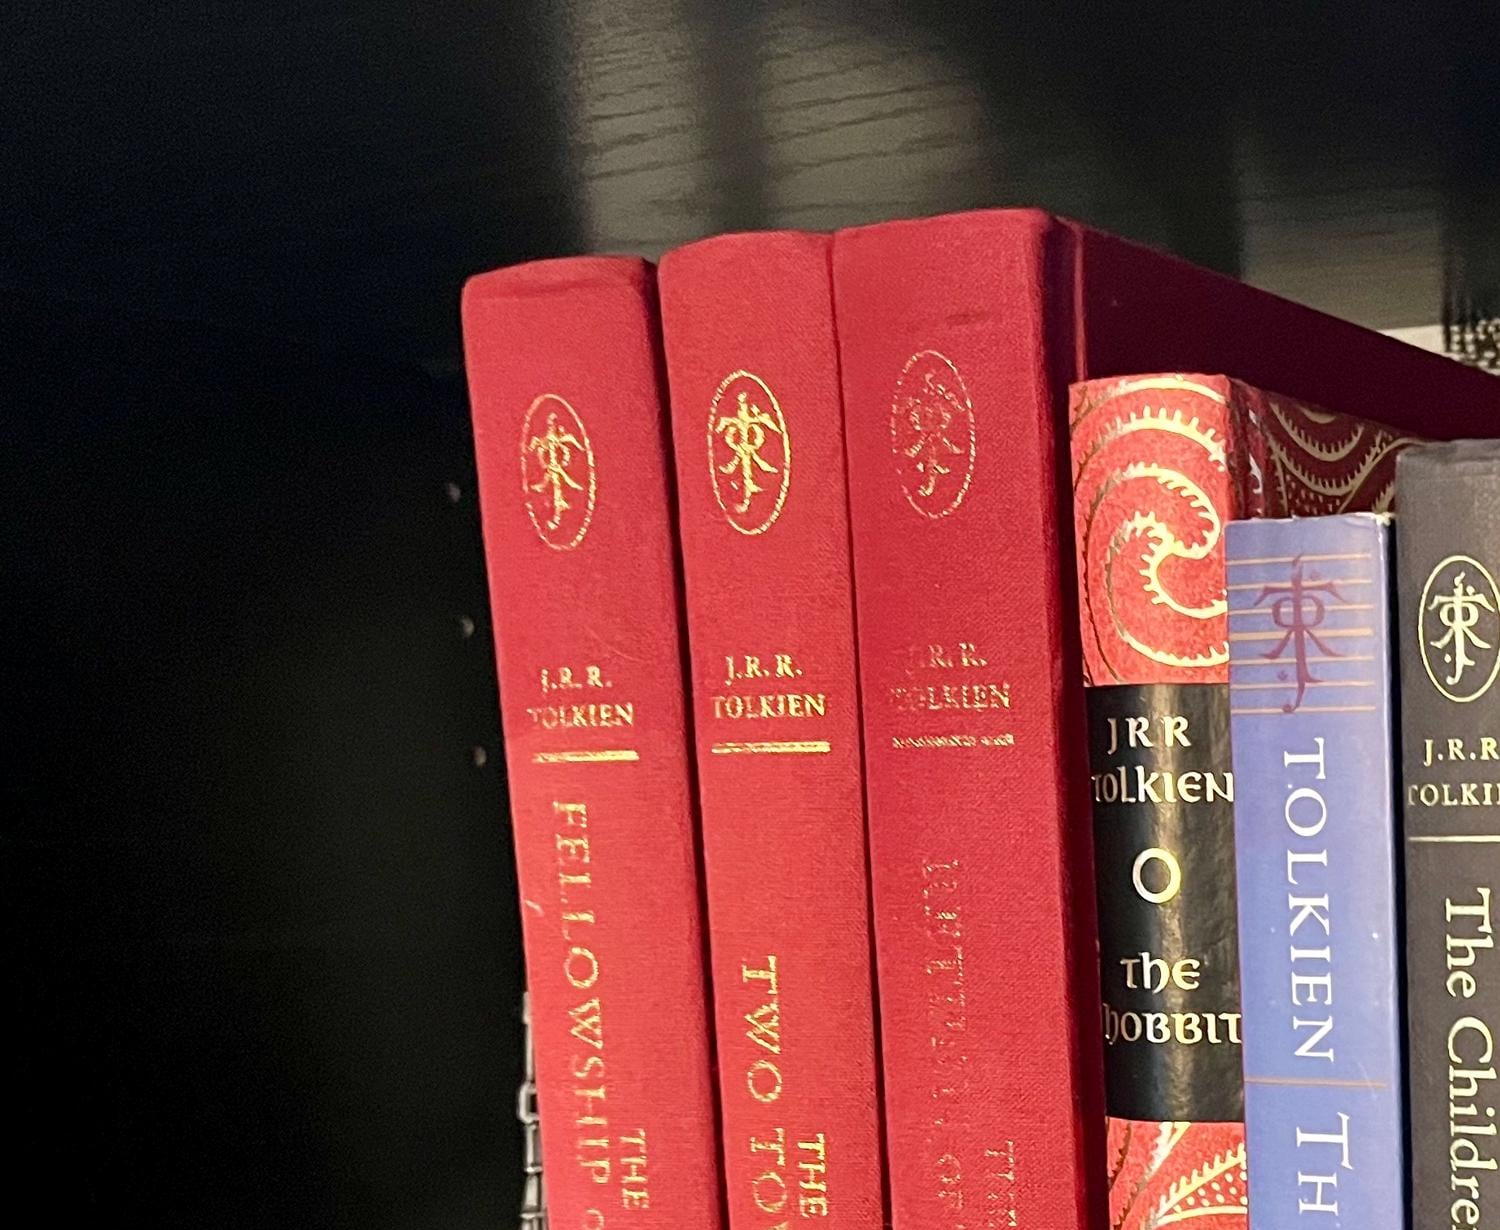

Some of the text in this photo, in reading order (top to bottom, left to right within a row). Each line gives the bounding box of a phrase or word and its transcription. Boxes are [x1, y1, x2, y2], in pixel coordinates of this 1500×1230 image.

[526, 702, 634, 729] TOLKIEN
[711, 693, 825, 719] TOLKIEN
[1091, 765, 1235, 803] TOLKIEN
[1283, 737, 1334, 1063] TOLKIEN
[1445, 887, 1493, 999] The
[553, 801, 610, 1184] FELLOWSHIP
[741, 955, 782, 1103] TWO
[620, 1127, 649, 1209] THE
[798, 1132, 829, 1219] THE
